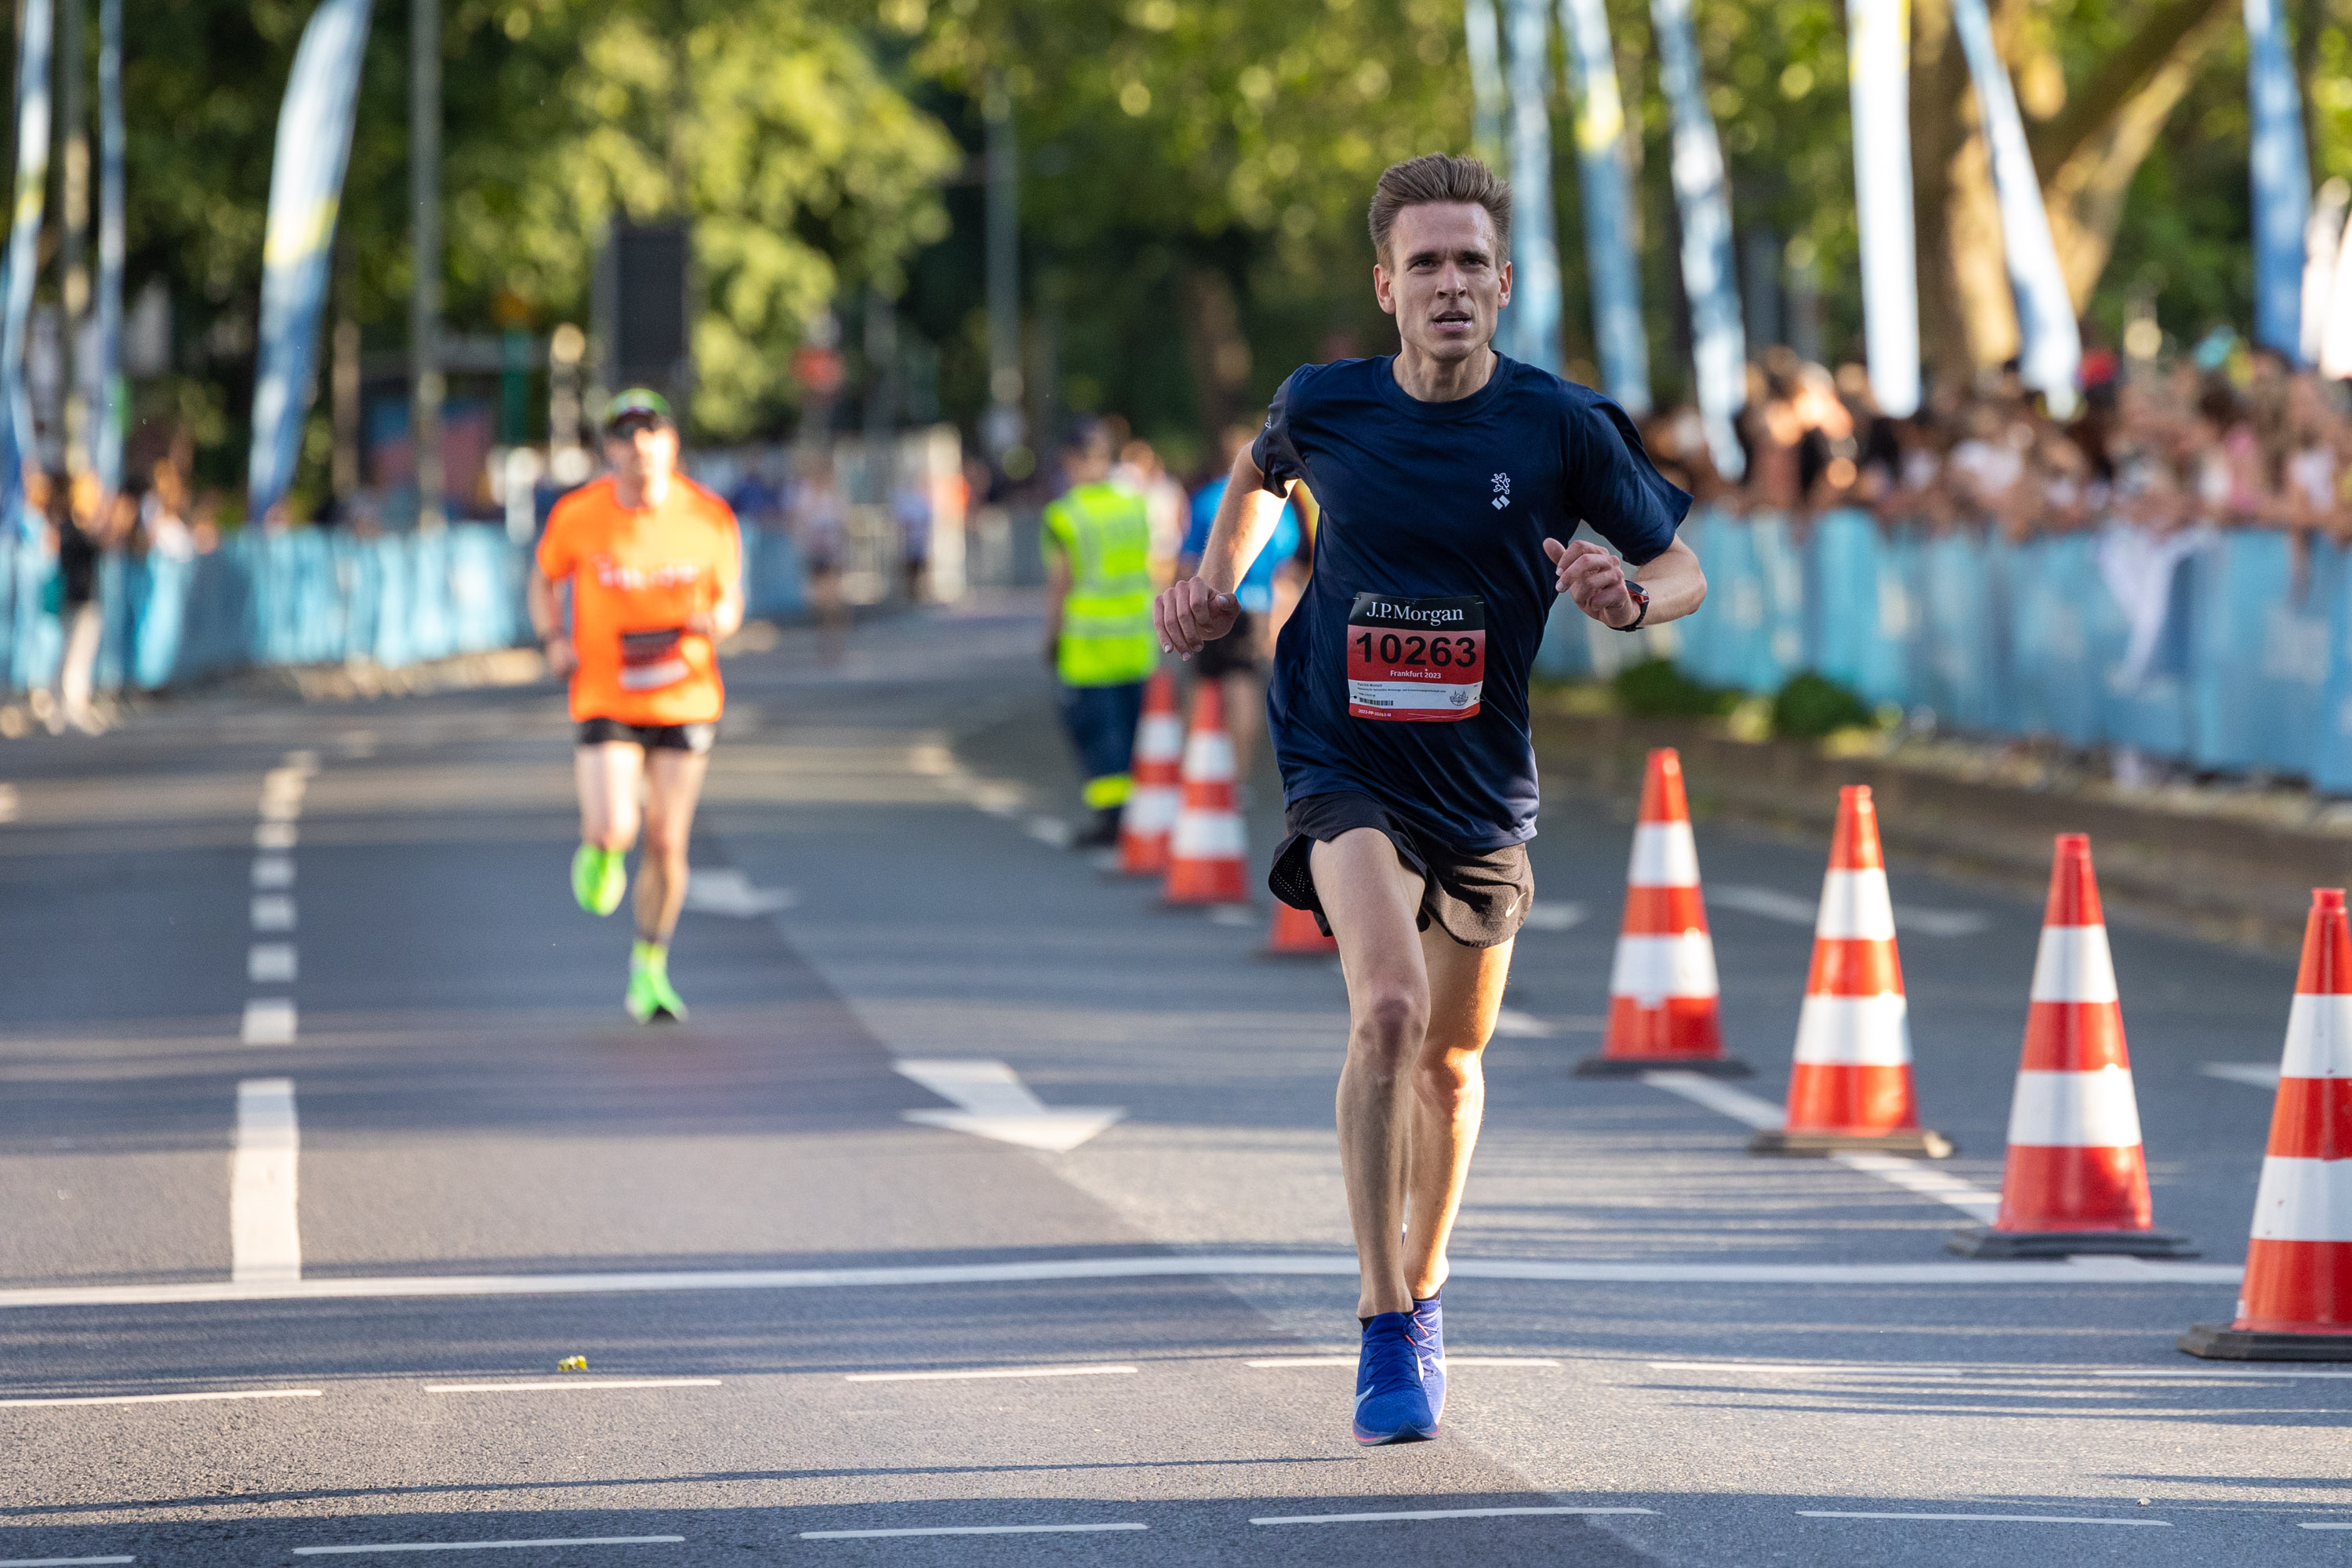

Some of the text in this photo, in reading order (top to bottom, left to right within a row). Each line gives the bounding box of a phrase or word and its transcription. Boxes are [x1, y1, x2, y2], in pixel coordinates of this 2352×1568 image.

[1367, 601, 1465, 626] J.P.Morgan
[1356, 632, 1476, 668] 10263
[1390, 670, 1423, 678] Frankfurt
